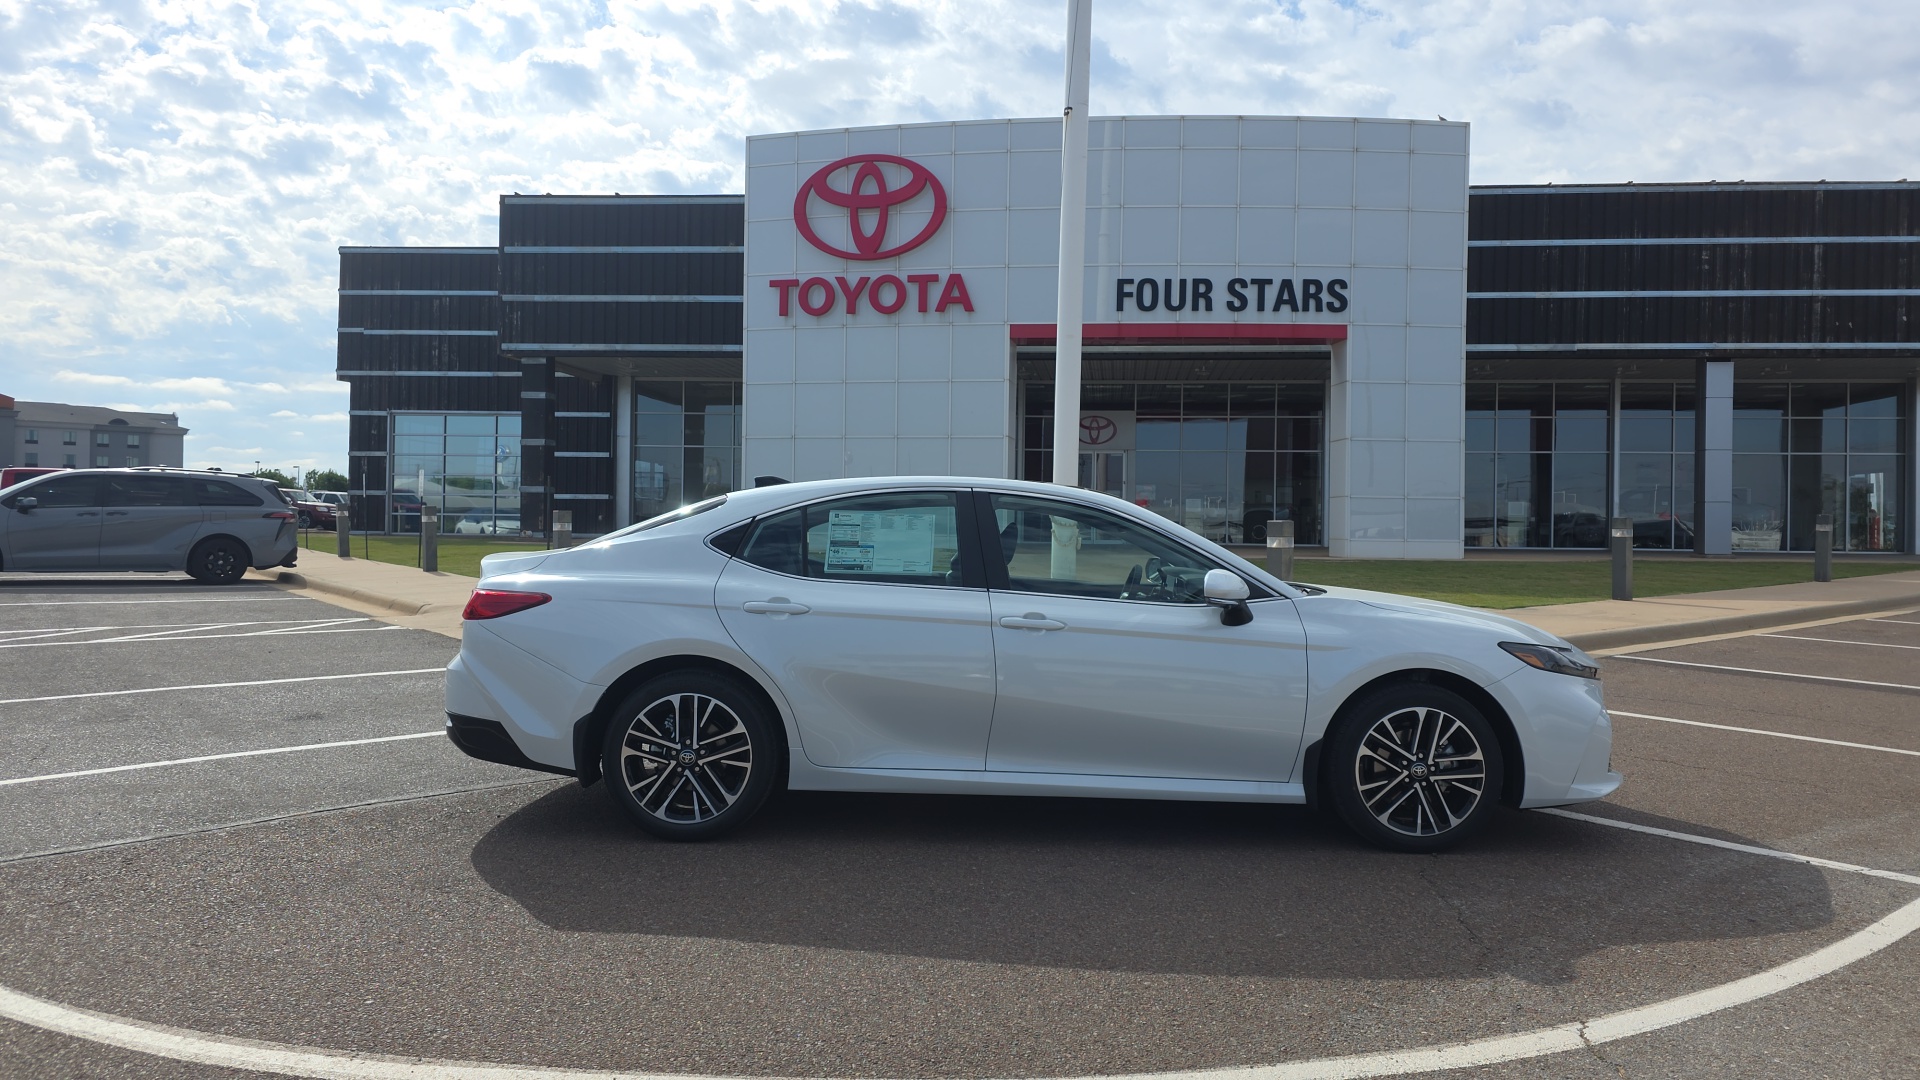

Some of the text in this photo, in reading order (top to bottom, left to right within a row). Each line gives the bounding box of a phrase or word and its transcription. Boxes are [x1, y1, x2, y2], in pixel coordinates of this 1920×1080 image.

[769, 273, 975, 317] TOYOTA
[1116, 277, 1348, 312] FOUR STARS
